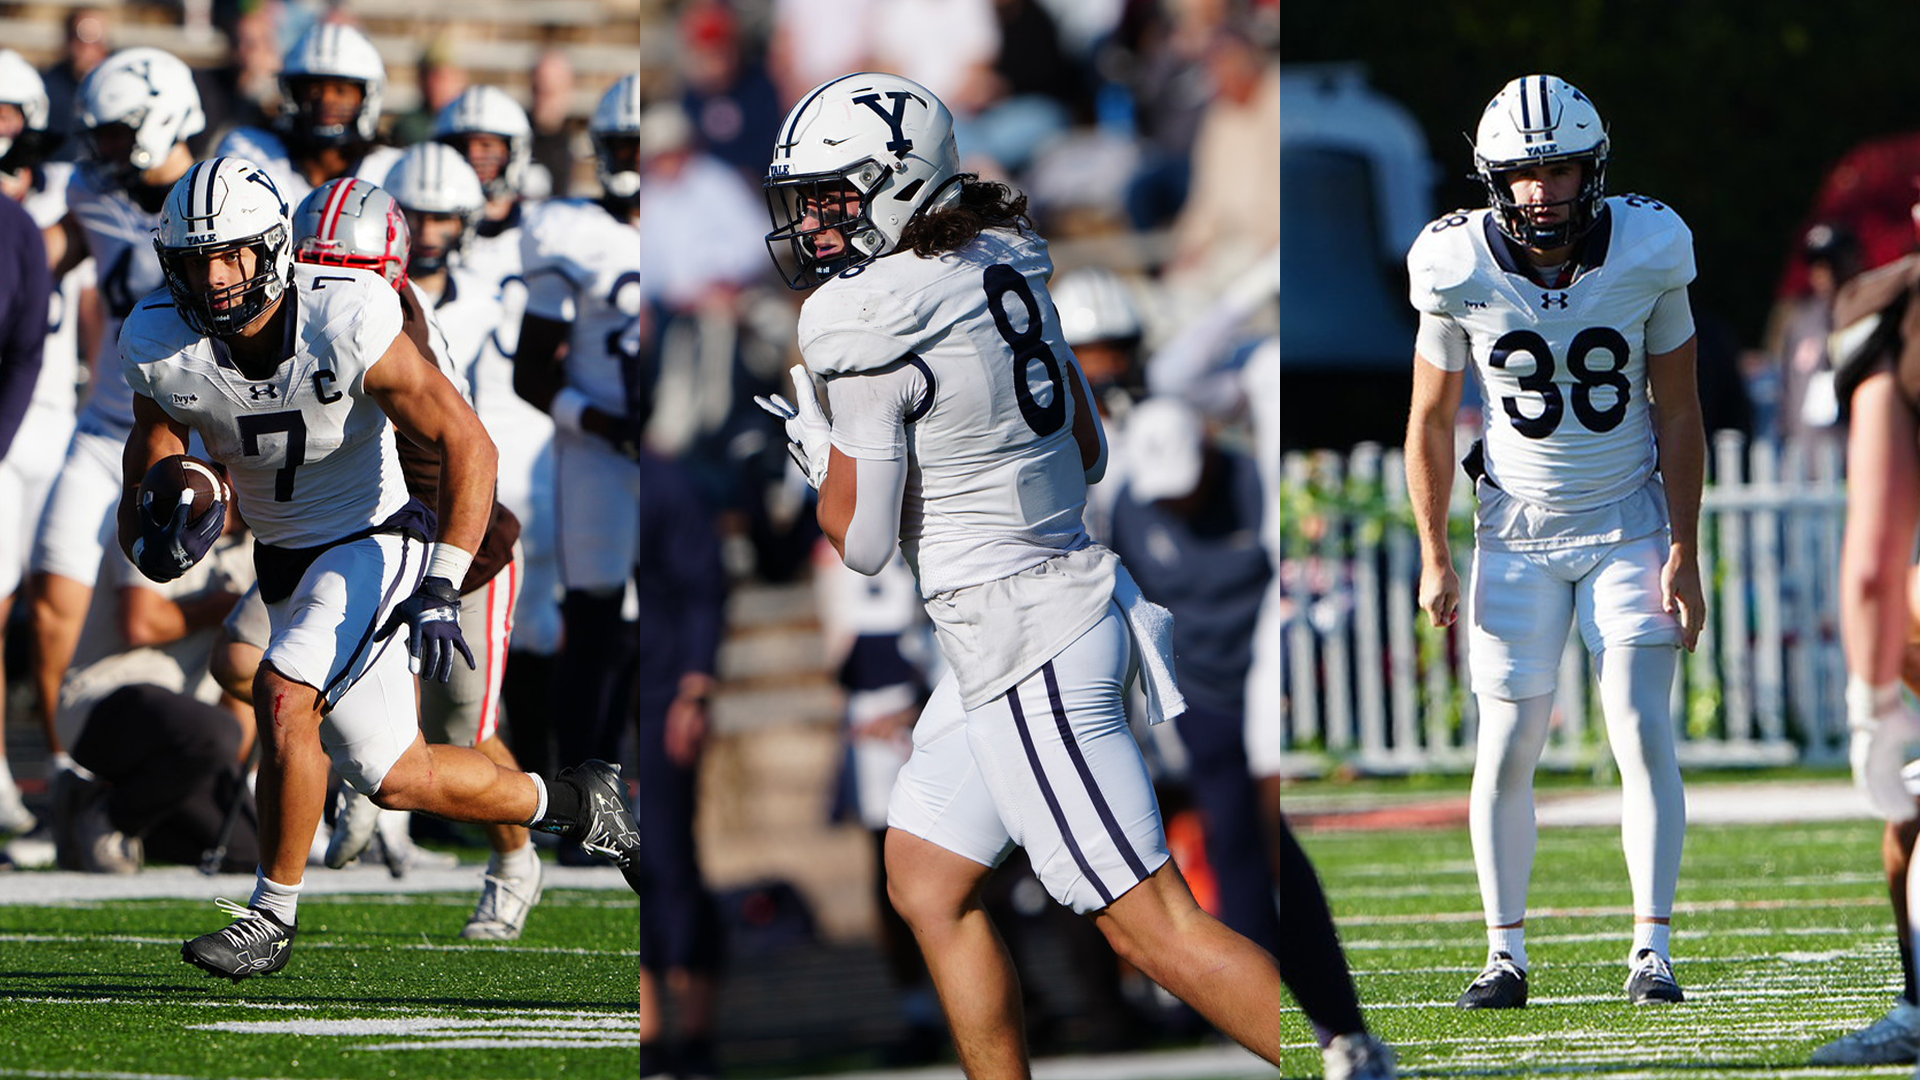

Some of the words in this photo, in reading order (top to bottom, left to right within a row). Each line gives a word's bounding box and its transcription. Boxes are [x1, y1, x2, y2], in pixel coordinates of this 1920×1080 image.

[123, 60, 160, 96] Y
[852, 91, 914, 153] Y
[1525, 144, 1558, 156] YALE
[770, 164, 790, 176] YALE
[246, 169, 289, 219] Y
[186, 233, 217, 245] YALE
[311, 275, 356, 291] 7
[983, 263, 1066, 437] 8
[173, 394, 189, 405] Ivy
[312, 369, 343, 405] C
[1489, 326, 1631, 439] 38
[236, 409, 306, 502] 7
